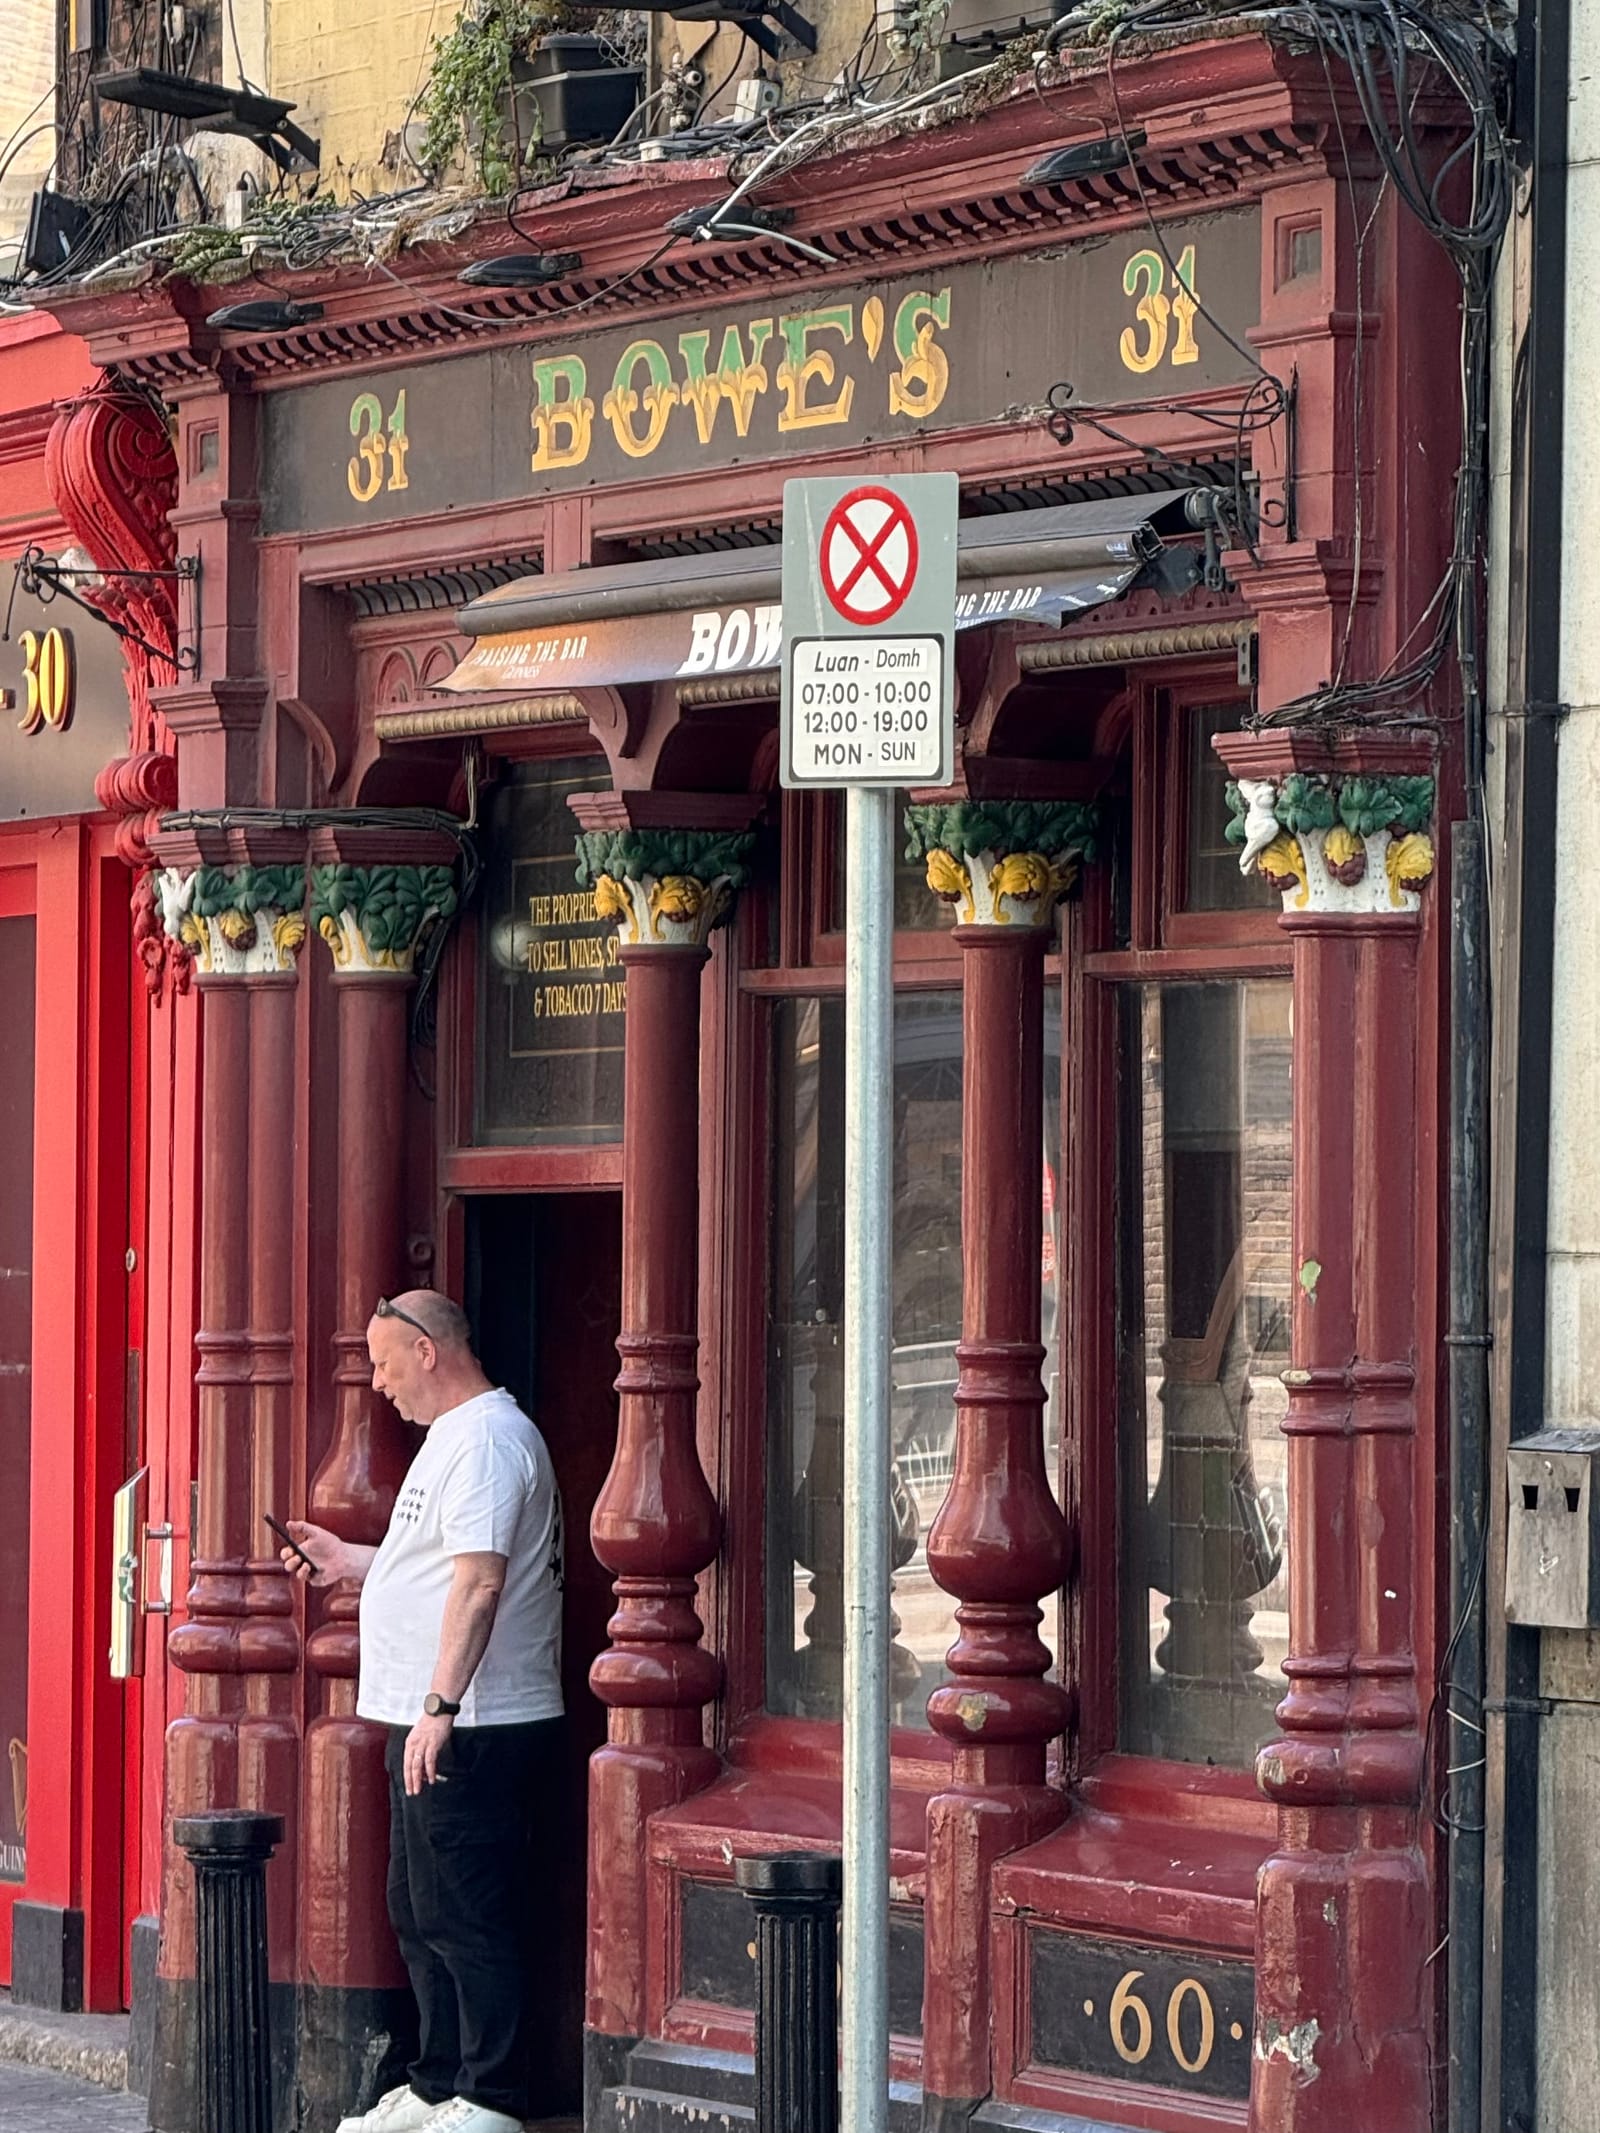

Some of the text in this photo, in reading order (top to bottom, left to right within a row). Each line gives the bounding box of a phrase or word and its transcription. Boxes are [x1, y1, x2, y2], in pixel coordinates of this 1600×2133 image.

[347, 244, 1201, 502] 31 BOWE'S 31
[978, 590, 1010, 616] THE
[1008, 586, 1042, 611] BAR
[532, 639, 559, 663] THE
[559, 636, 588, 660] BAR
[813, 650, 860, 673] Luan
[876, 647, 921, 668] Domh
[17, 627, 69, 735] 30
[801, 682, 860, 705] 07:00
[874, 680, 932, 704] 10:00
[803, 710, 858, 734] 12:00
[873, 709, 928, 733] 19:00
[813, 742, 862, 766] MON
[880, 741, 916, 762] SUN
[529, 891, 601, 927] THE PROPRIE
[527, 935, 625, 974] TO SELL WINES, SP
[533, 986, 543, 1018] &
[544, 982, 594, 1017] TOBACCO
[594, 983, 602, 1014] 7
